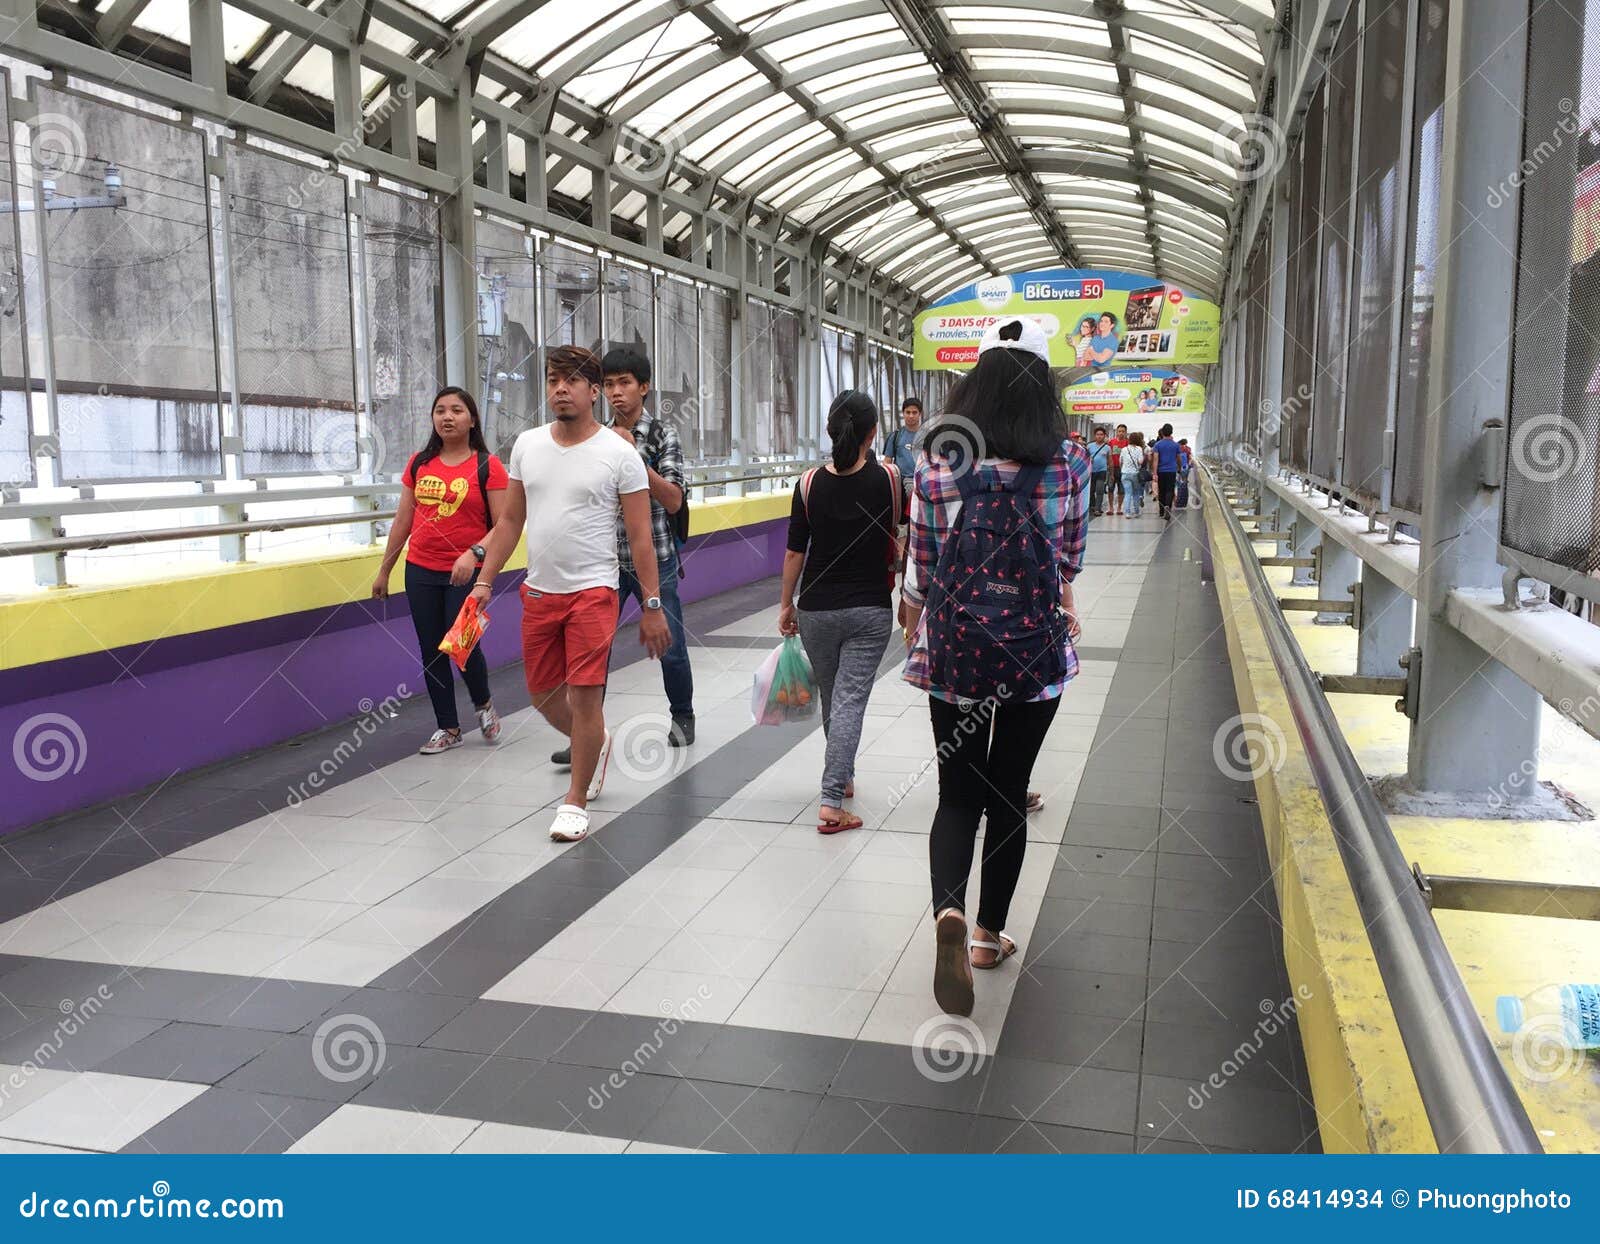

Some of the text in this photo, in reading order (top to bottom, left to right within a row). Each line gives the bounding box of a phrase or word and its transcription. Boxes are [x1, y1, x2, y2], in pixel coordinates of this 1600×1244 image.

[1051, 288, 1081, 300] bytes
[1084, 284, 1101, 296] 50
[939, 319, 946, 328] 3
[950, 317, 975, 328] DAYS
[975, 317, 989, 327] of
[935, 329, 970, 340] movies,
[940, 350, 979, 363] To registe
